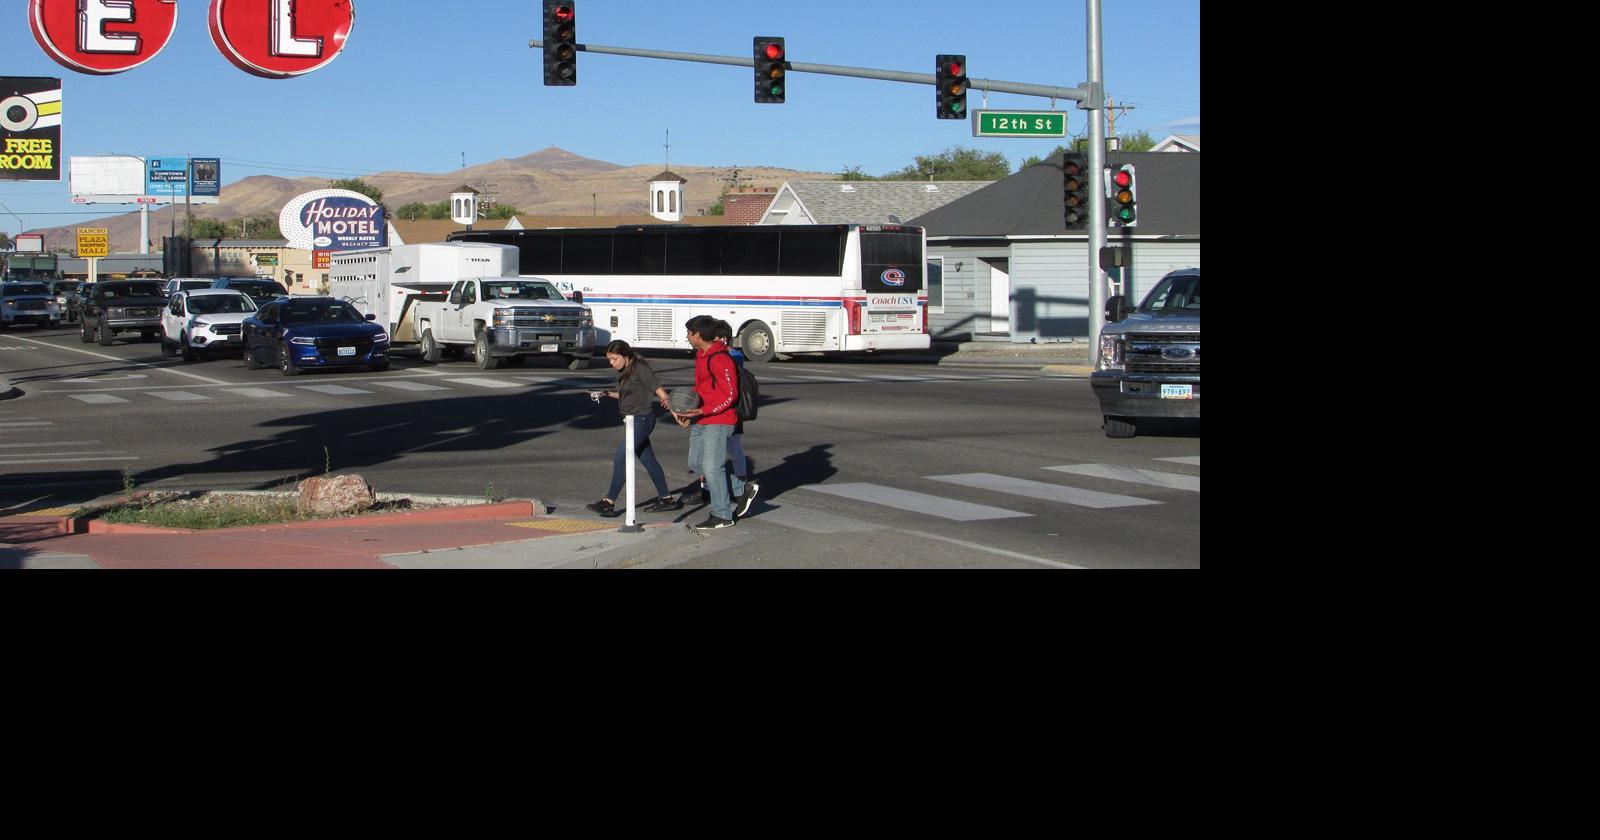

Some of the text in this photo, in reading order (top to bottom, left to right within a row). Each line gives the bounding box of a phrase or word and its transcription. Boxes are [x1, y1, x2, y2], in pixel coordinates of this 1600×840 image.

[992, 118, 1052, 130] 12th St
[5, 138, 53, 154] FREE
[0, 155, 53, 170] ROOM
[318, 221, 379, 234] MOTEL
[871, 296, 913, 305] Coach USA
